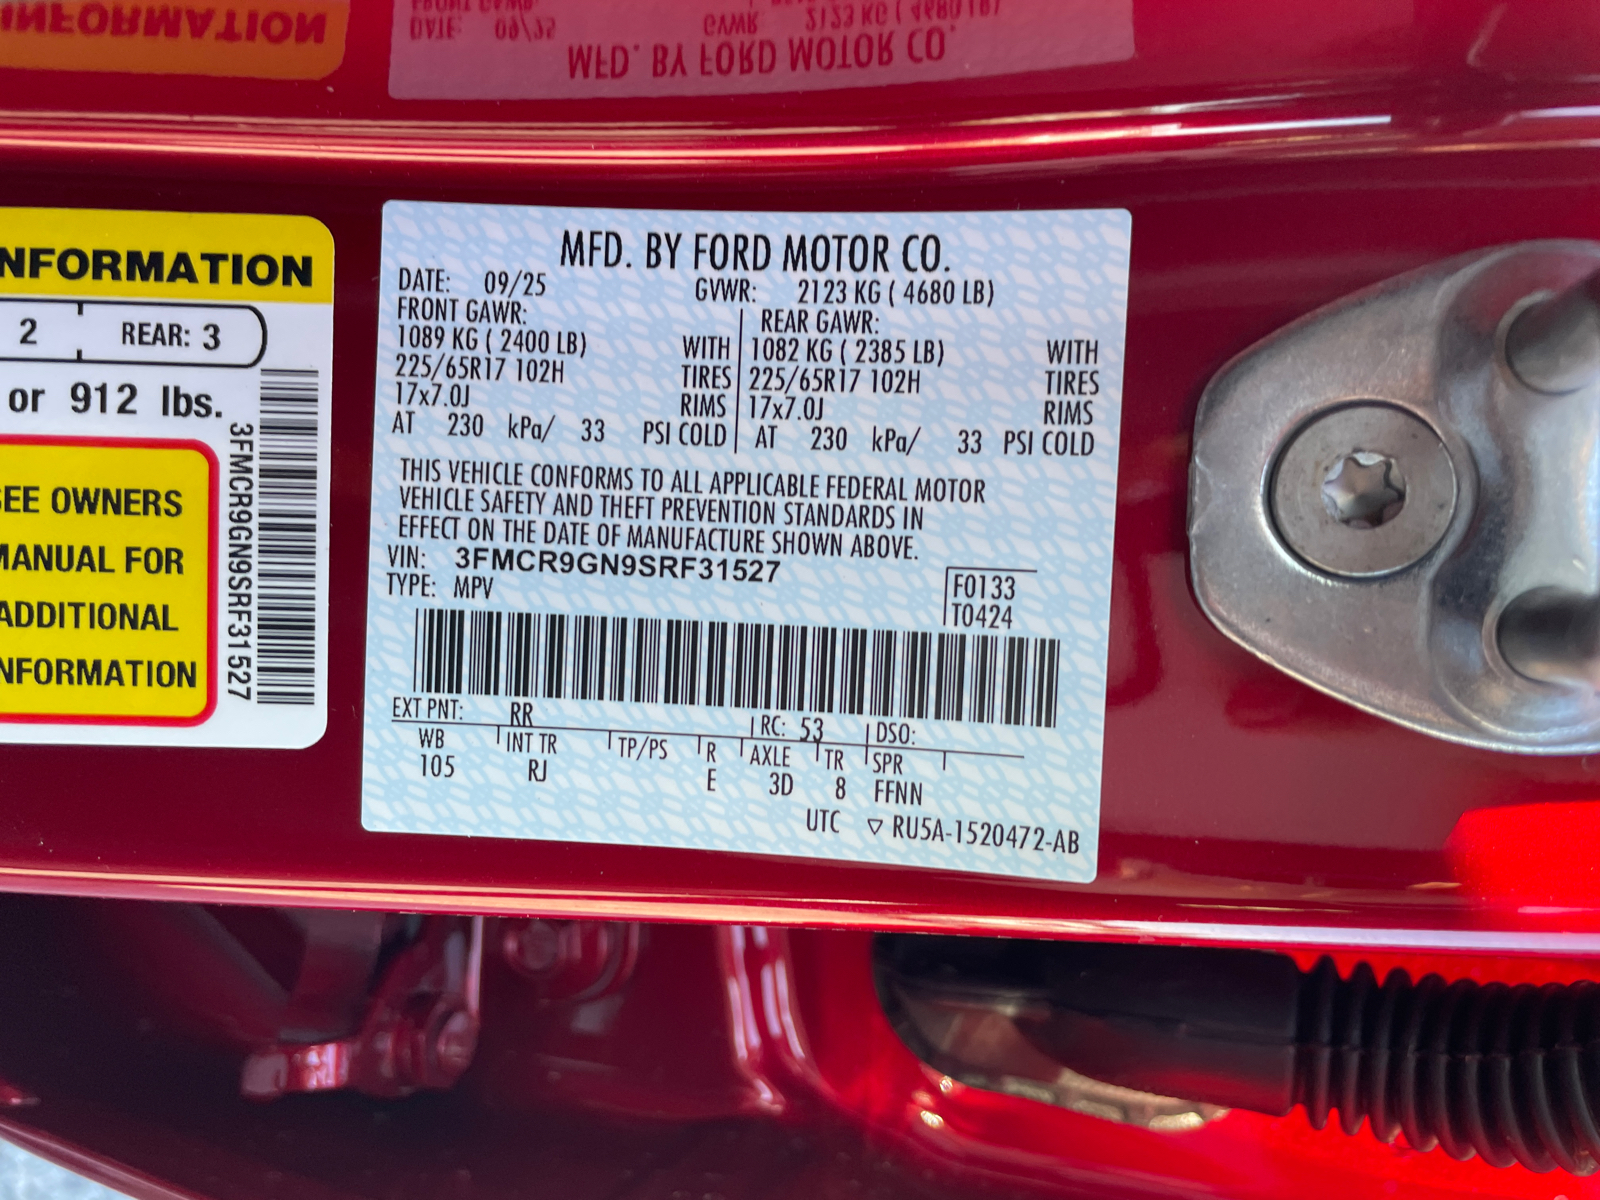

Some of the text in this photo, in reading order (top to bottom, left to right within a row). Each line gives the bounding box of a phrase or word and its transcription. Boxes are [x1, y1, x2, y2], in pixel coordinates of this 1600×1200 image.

[560, 230, 951, 273] MFD. BY FORD MOTOR CO.
[398, 267, 547, 298] DATE: 09/25
[695, 277, 757, 303] GVWR:
[797, 280, 847, 304] 2123
[854, 280, 881, 304] KG
[903, 280, 955, 305] 4680
[962, 279, 995, 308] LB)
[398, 297, 527, 325] FRONT GAWR:
[761, 309, 880, 334] REAR GAWR:
[19, 318, 37, 345] 2
[121, 321, 221, 351] REAR: 3
[398, 325, 445, 349] 1089
[452, 327, 478, 351] KG
[500, 329, 550, 354] 2400
[557, 331, 587, 358] LB)
[683, 336, 731, 360] WITH
[751, 337, 799, 362] 1082
[806, 338, 833, 363] KG
[855, 339, 906, 364] 2385
[912, 339, 945, 368] LB)
[1046, 340, 1098, 364] WITH
[395, 353, 732, 390] 225/65R17 102H TIRES
[748, 365, 1100, 395] 225/65R17 102H TIRES
[8, 382, 223, 418] or 912 lbs.
[395, 382, 727, 418] 17x7.0J RIMS
[749, 396, 1094, 425] 17x7.0J RIMS
[392, 411, 727, 447] AT 230 kPa/ 33 PSI COLD
[754, 425, 1095, 456] AT 230 kPa/ 33 PSI COLD
[400, 458, 986, 503] THIS VEHICLE CONFORMS TO ALL APPLICABLE FEDERAL MOTOR
[0, 485, 183, 518] EE OWNERS
[400, 485, 924, 530] VEHICLE SAFETY AND THEFT PREVENTION STANDARDS IN
[399, 515, 919, 560] EFFECT ON THE DATE OF MANUFACTURE SHOWN ABOVE.
[125, 546, 184, 575] FOR
[227, 422, 254, 701] 3FMCR9GN9SRF31527
[387, 544, 781, 583] VIN: 3FMCR9GN9SRF31527
[386, 572, 494, 600] TYPE: MPV
[0, 601, 179, 631] ADDITIONAL
[392, 697, 534, 727] EXT PNT: RR
[418, 727, 445, 749] WB
[506, 731, 558, 755] INT TR
[761, 714, 824, 743] RC: 53
[876, 722, 916, 746] DSO:
[618, 736, 668, 761] TP/PS
[706, 741, 716, 763] R
[750, 744, 791, 768] AXLE
[825, 749, 844, 771] TR
[420, 754, 455, 778] 105
[528, 759, 548, 782] RJ
[872, 752, 904, 776] SPR
[707, 768, 717, 792] E
[769, 772, 794, 796] 3D
[835, 776, 846, 800] 8
[874, 779, 923, 806] FFNN
[806, 808, 1080, 855] UTC RU5A-1520472-AB
